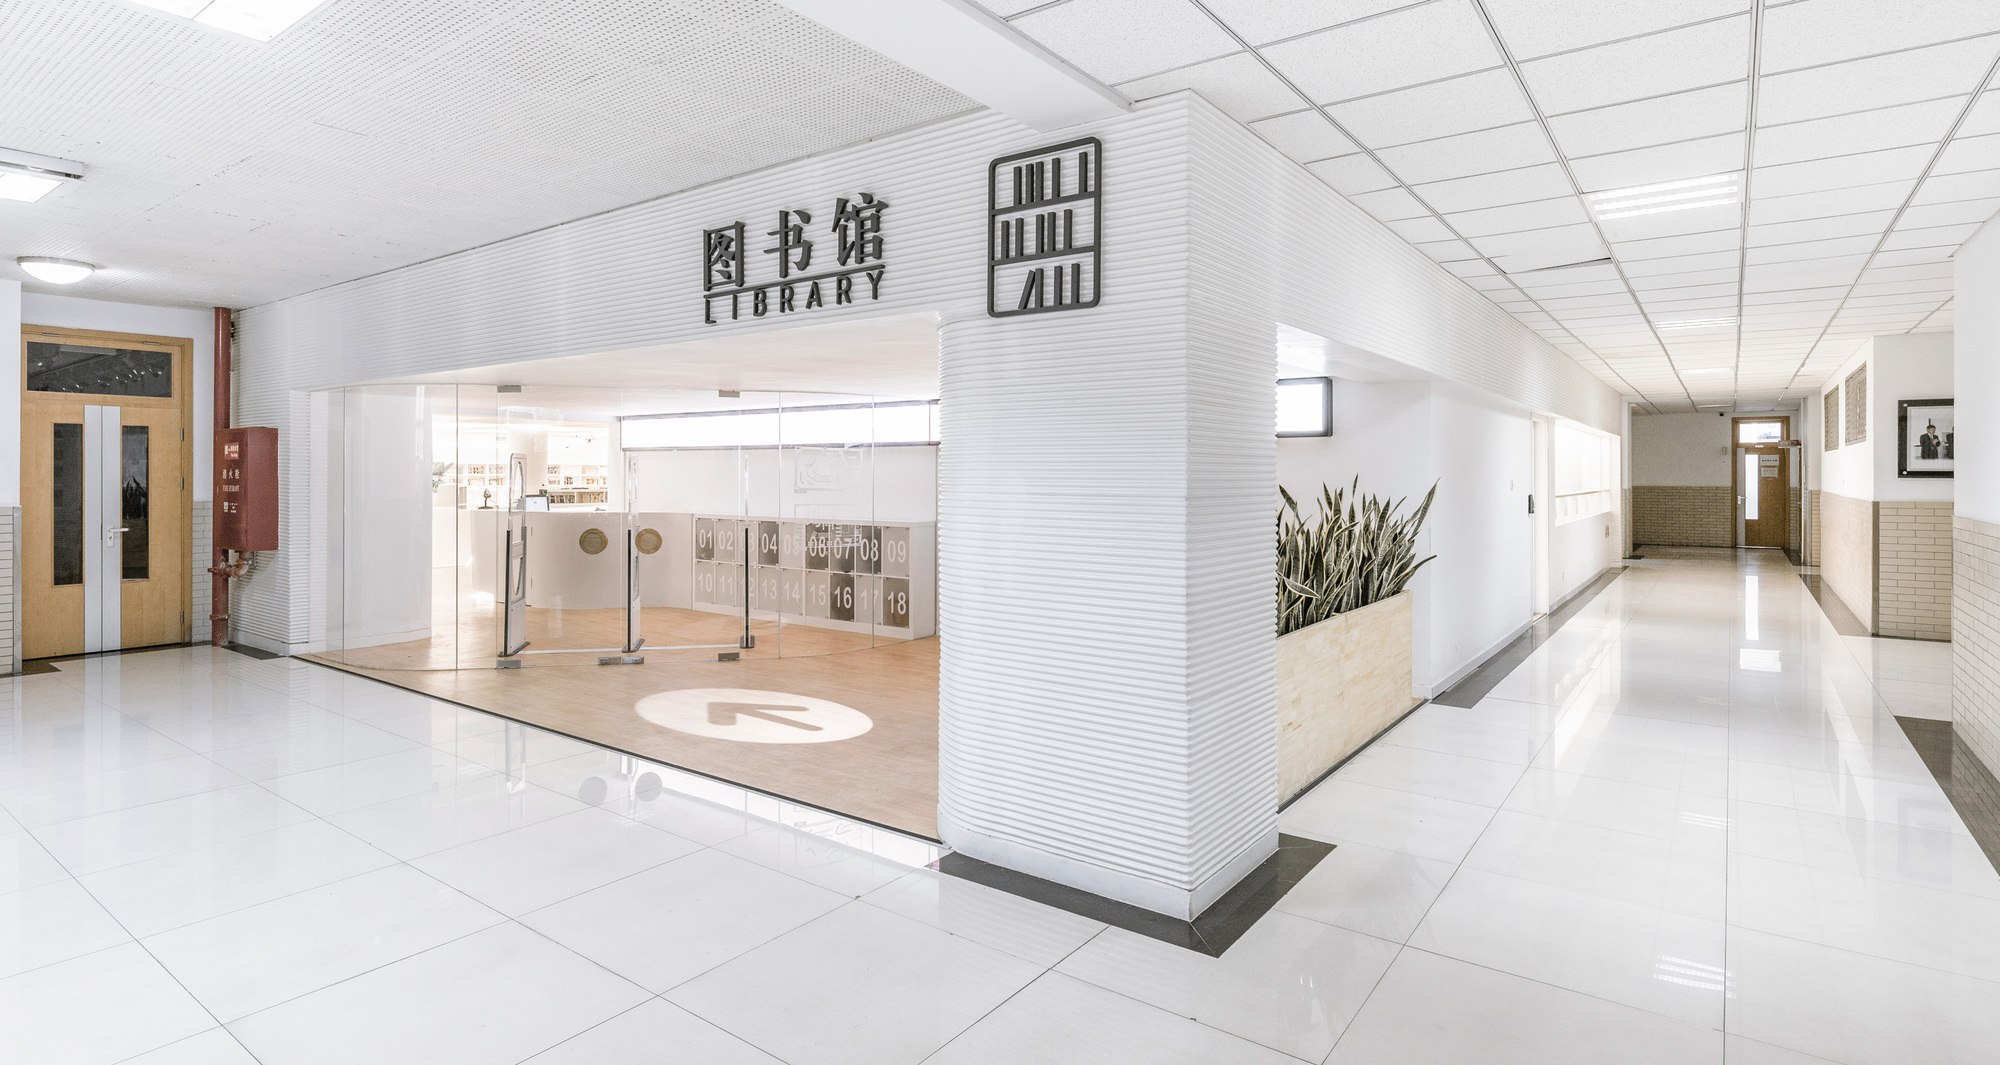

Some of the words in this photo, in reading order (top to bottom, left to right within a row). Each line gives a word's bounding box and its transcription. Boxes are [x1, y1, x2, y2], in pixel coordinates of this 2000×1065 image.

[703, 192, 889, 292] 图书馆
[704, 269, 885, 325] LIBRARY
[700, 529, 712, 549] 01
[719, 531, 733, 550] 02
[762, 533, 777, 554] 04
[809, 535, 827, 558] 06
[834, 537, 853, 560] 07
[860, 538, 879, 562] 08
[887, 540, 906, 563] 09
[697, 573, 712, 592] 10
[720, 575, 733, 595] 11
[762, 579, 777, 599] 13
[784, 582, 800, 603] 14
[810, 583, 826, 605] 15
[834, 586, 852, 609] 16
[861, 588, 879, 610] 17
[887, 591, 907, 615] 18
